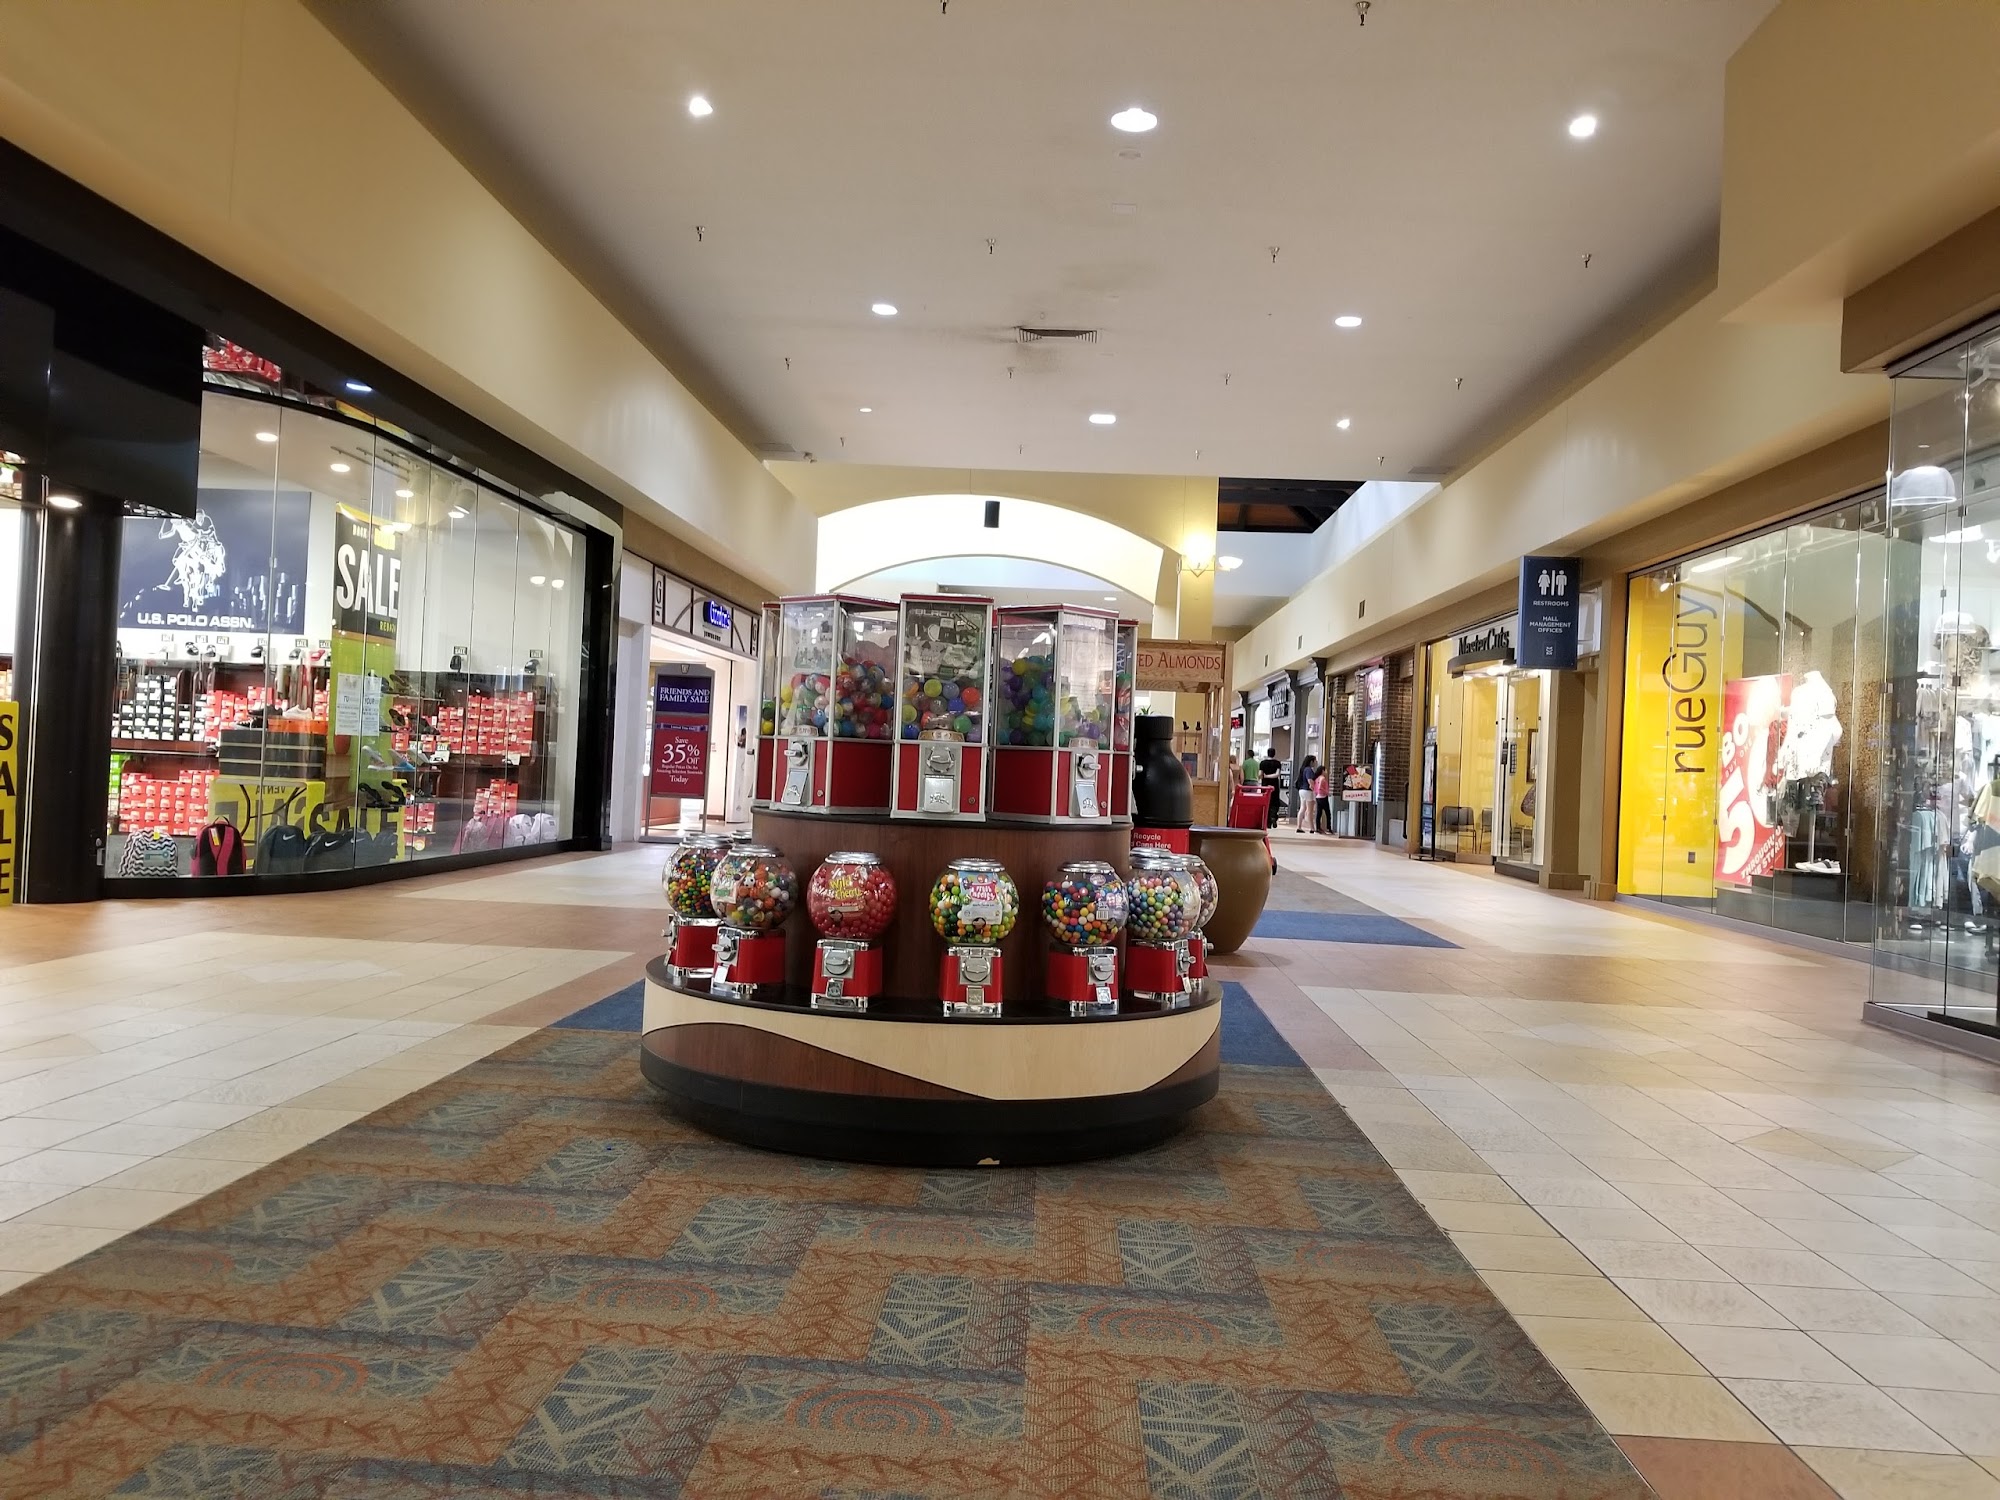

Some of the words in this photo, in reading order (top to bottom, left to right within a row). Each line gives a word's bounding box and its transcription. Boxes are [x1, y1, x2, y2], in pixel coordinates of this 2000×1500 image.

[336, 543, 401, 618] SALE
[137, 612, 164, 625] U.S.
[167, 614, 207, 627] POLO
[209, 616, 255, 629] ASSN.
[1458, 627, 1510, 655] MasterCuts
[1158, 652, 1221, 670] ALMONDS
[660, 687, 692, 695] FRIENDS
[695, 688, 710, 696] AND
[1662, 594, 1717, 773] rueGuy
[660, 694, 690, 702] FAMILY
[662, 743, 700, 765] 35%
[670, 775, 688, 784] Today
[1133, 832, 1162, 841] Recycle
[830, 874, 852, 889] Wild
[835, 887, 863, 901] Cherry
